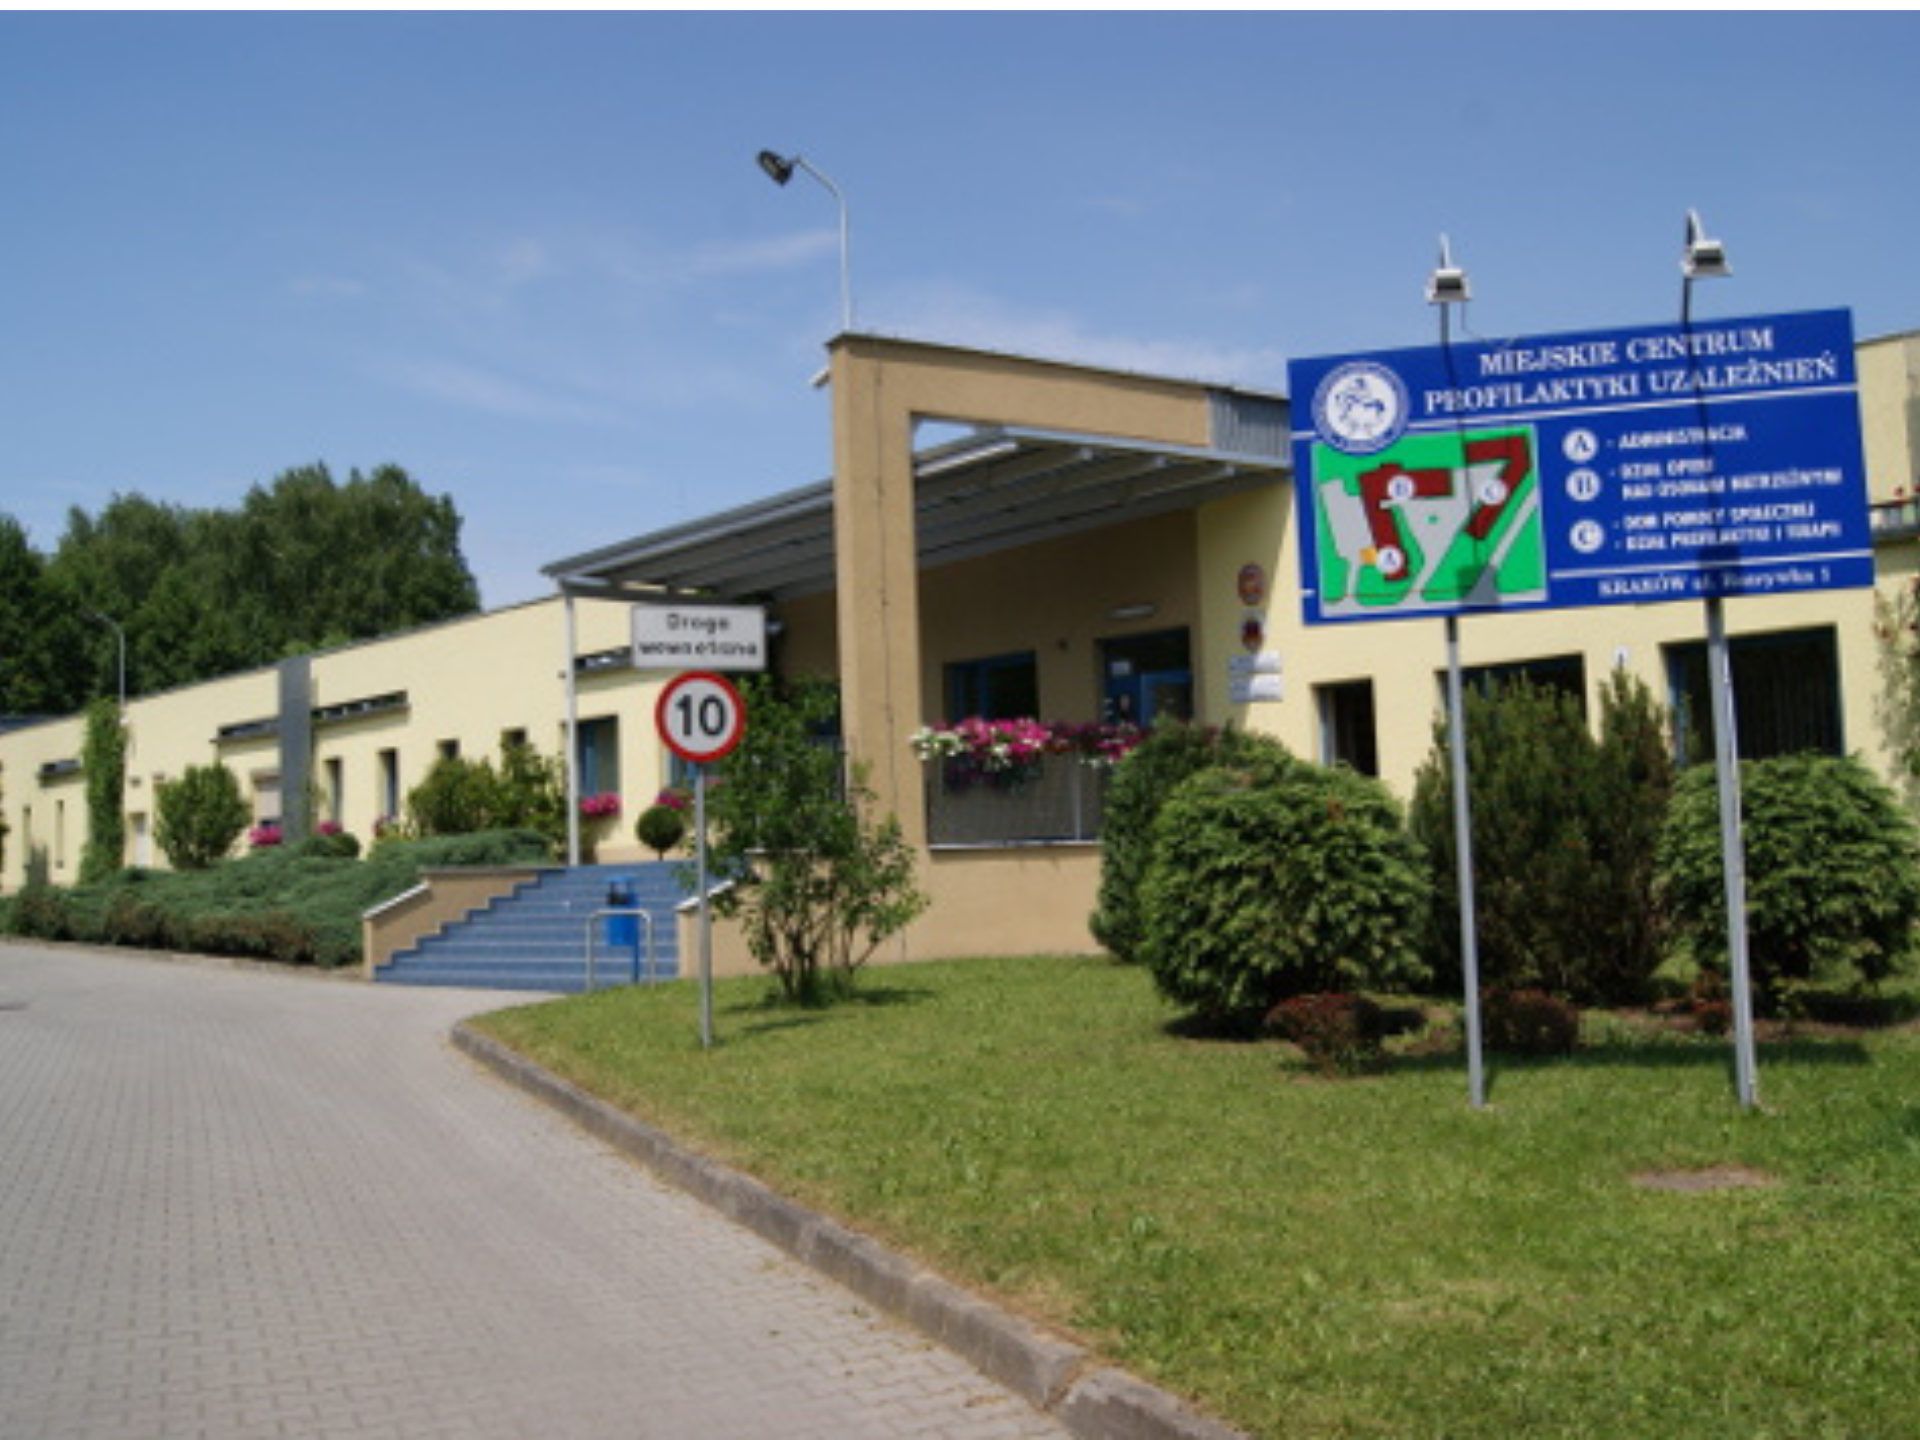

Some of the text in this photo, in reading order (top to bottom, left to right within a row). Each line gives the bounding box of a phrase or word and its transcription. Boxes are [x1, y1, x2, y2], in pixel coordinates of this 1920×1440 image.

[1478, 328, 1774, 376] MIEJSKIE CENTRUM
[1424, 371, 1639, 414] PROFILAKTYKI
[1649, 350, 1838, 393] UZALEŻNIEŃ
[675, 693, 726, 737] 10
